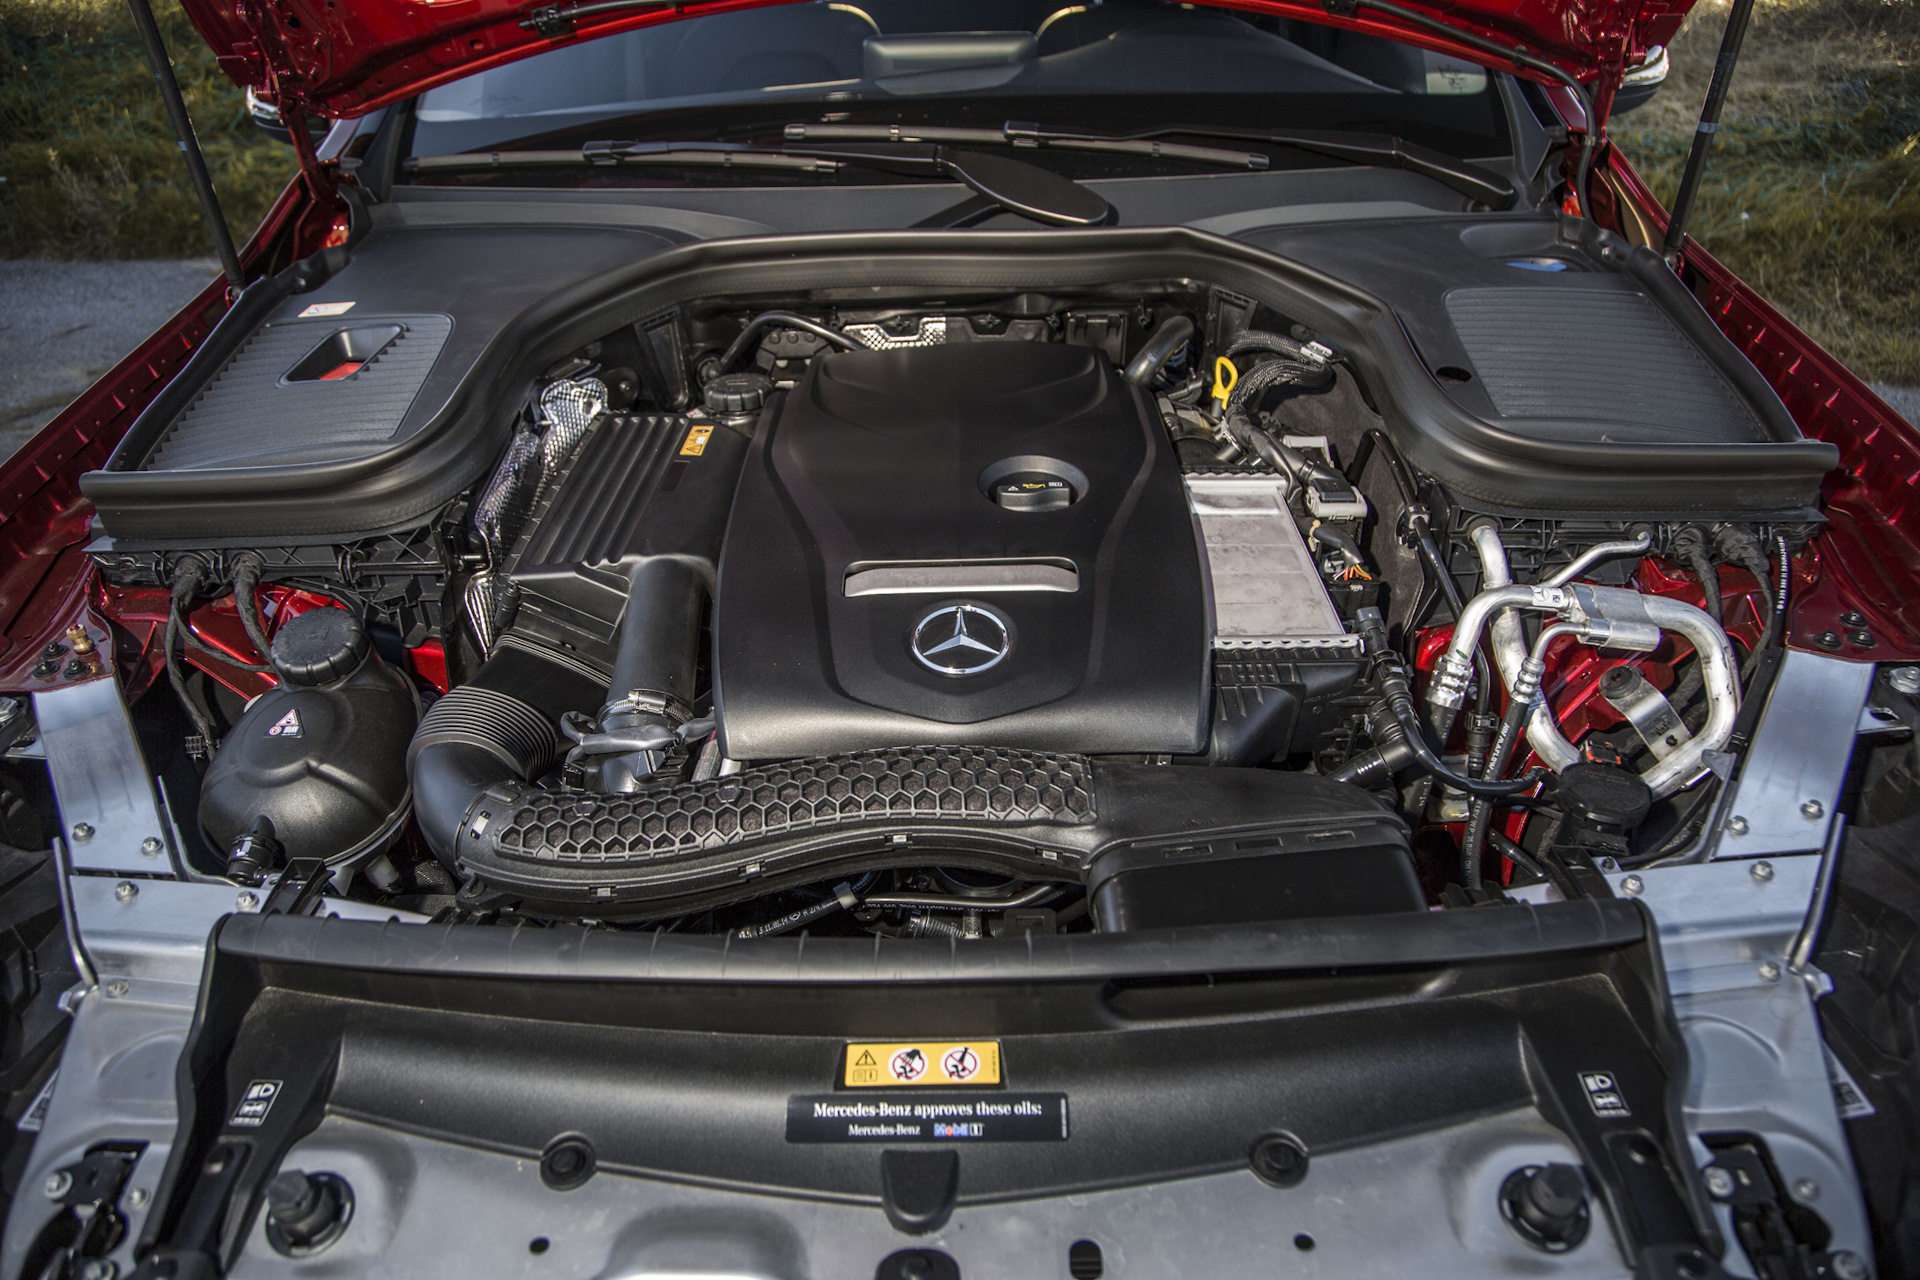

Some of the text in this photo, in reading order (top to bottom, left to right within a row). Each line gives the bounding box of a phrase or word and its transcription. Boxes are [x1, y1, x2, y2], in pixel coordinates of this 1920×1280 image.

[813, 1101, 1042, 1119] Mercedes-Benz approves these oils:
[848, 1123, 921, 1136] Mercedes-Benz
[934, 1123, 969, 1137] Mobil
